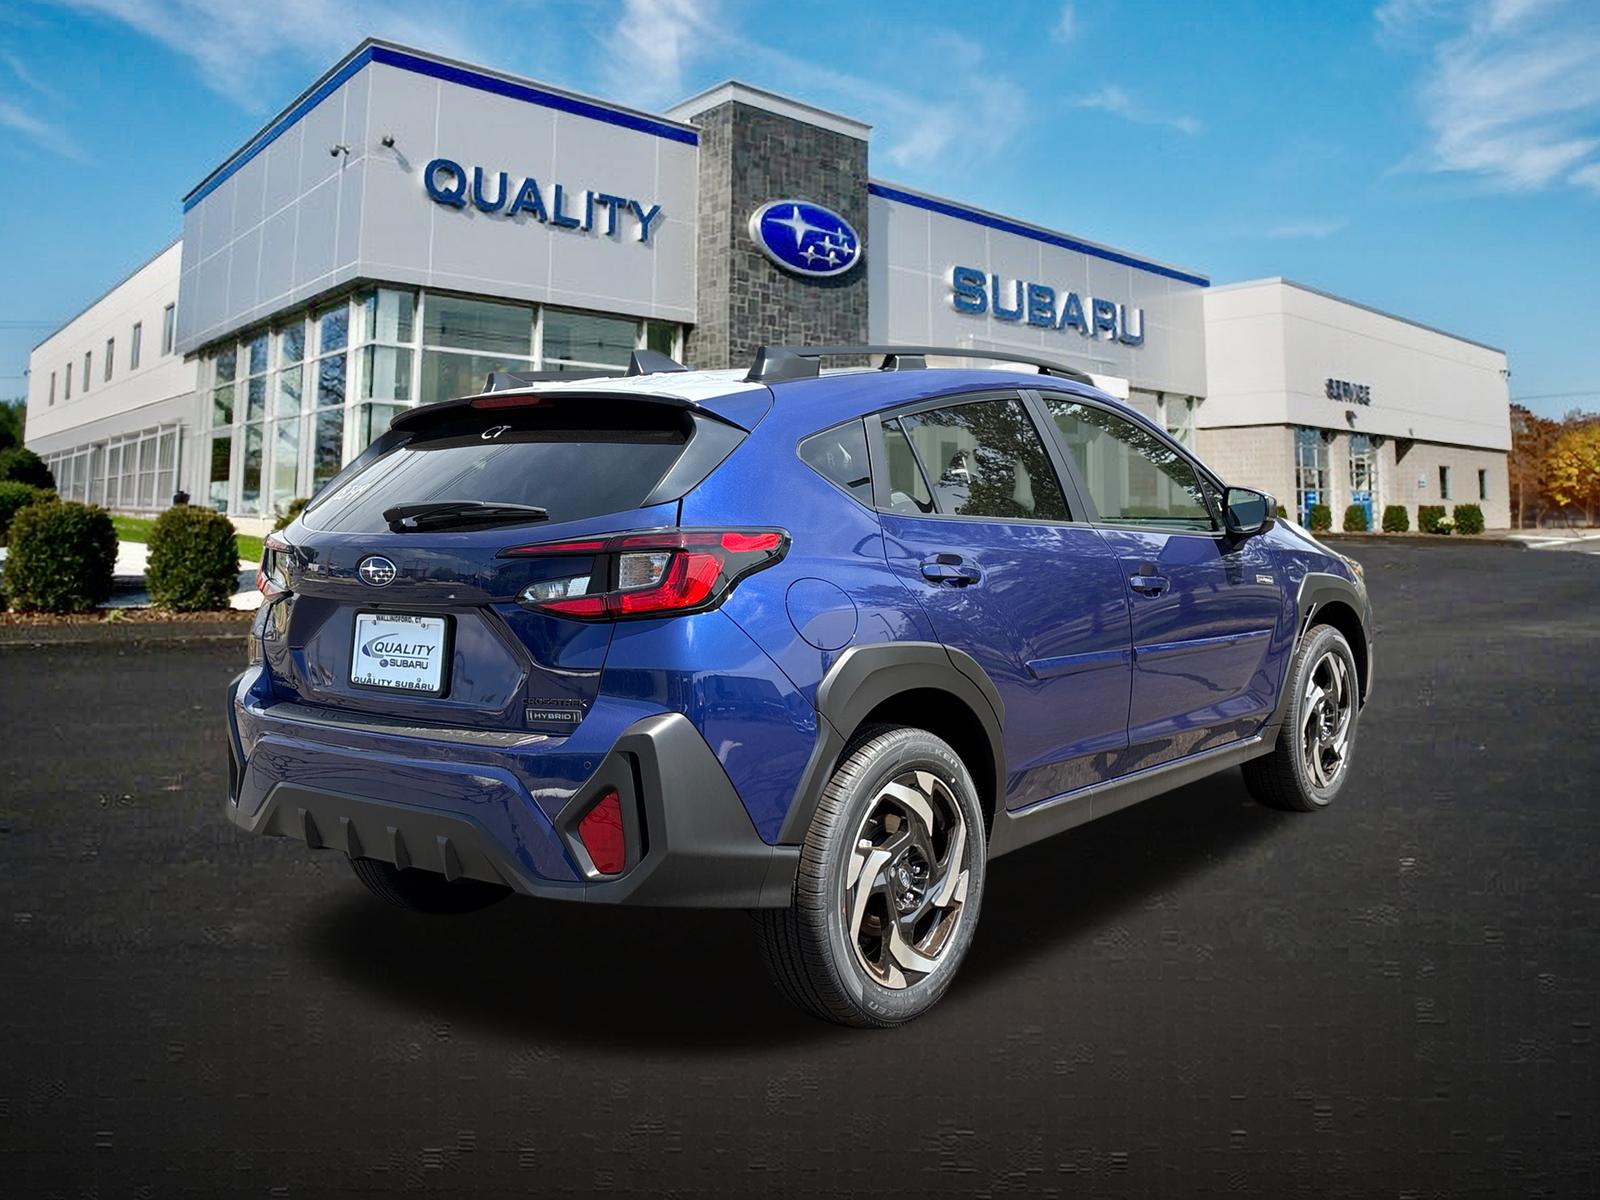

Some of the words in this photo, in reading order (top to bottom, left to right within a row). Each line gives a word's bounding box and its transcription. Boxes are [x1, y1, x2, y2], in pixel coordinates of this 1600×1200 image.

[424, 158, 662, 242] QUALITY
[950, 265, 1145, 346] SUBARU
[1325, 378, 1371, 405] SERVICE
[481, 425, 512, 439] CT
[414, 616, 422, 624] CT
[374, 641, 436, 656] QUALITY
[389, 658, 429, 670] SUBARU
[353, 676, 393, 687] QUALITY
[394, 680, 435, 691] SUBARU
[533, 711, 572, 720] HYBRID
